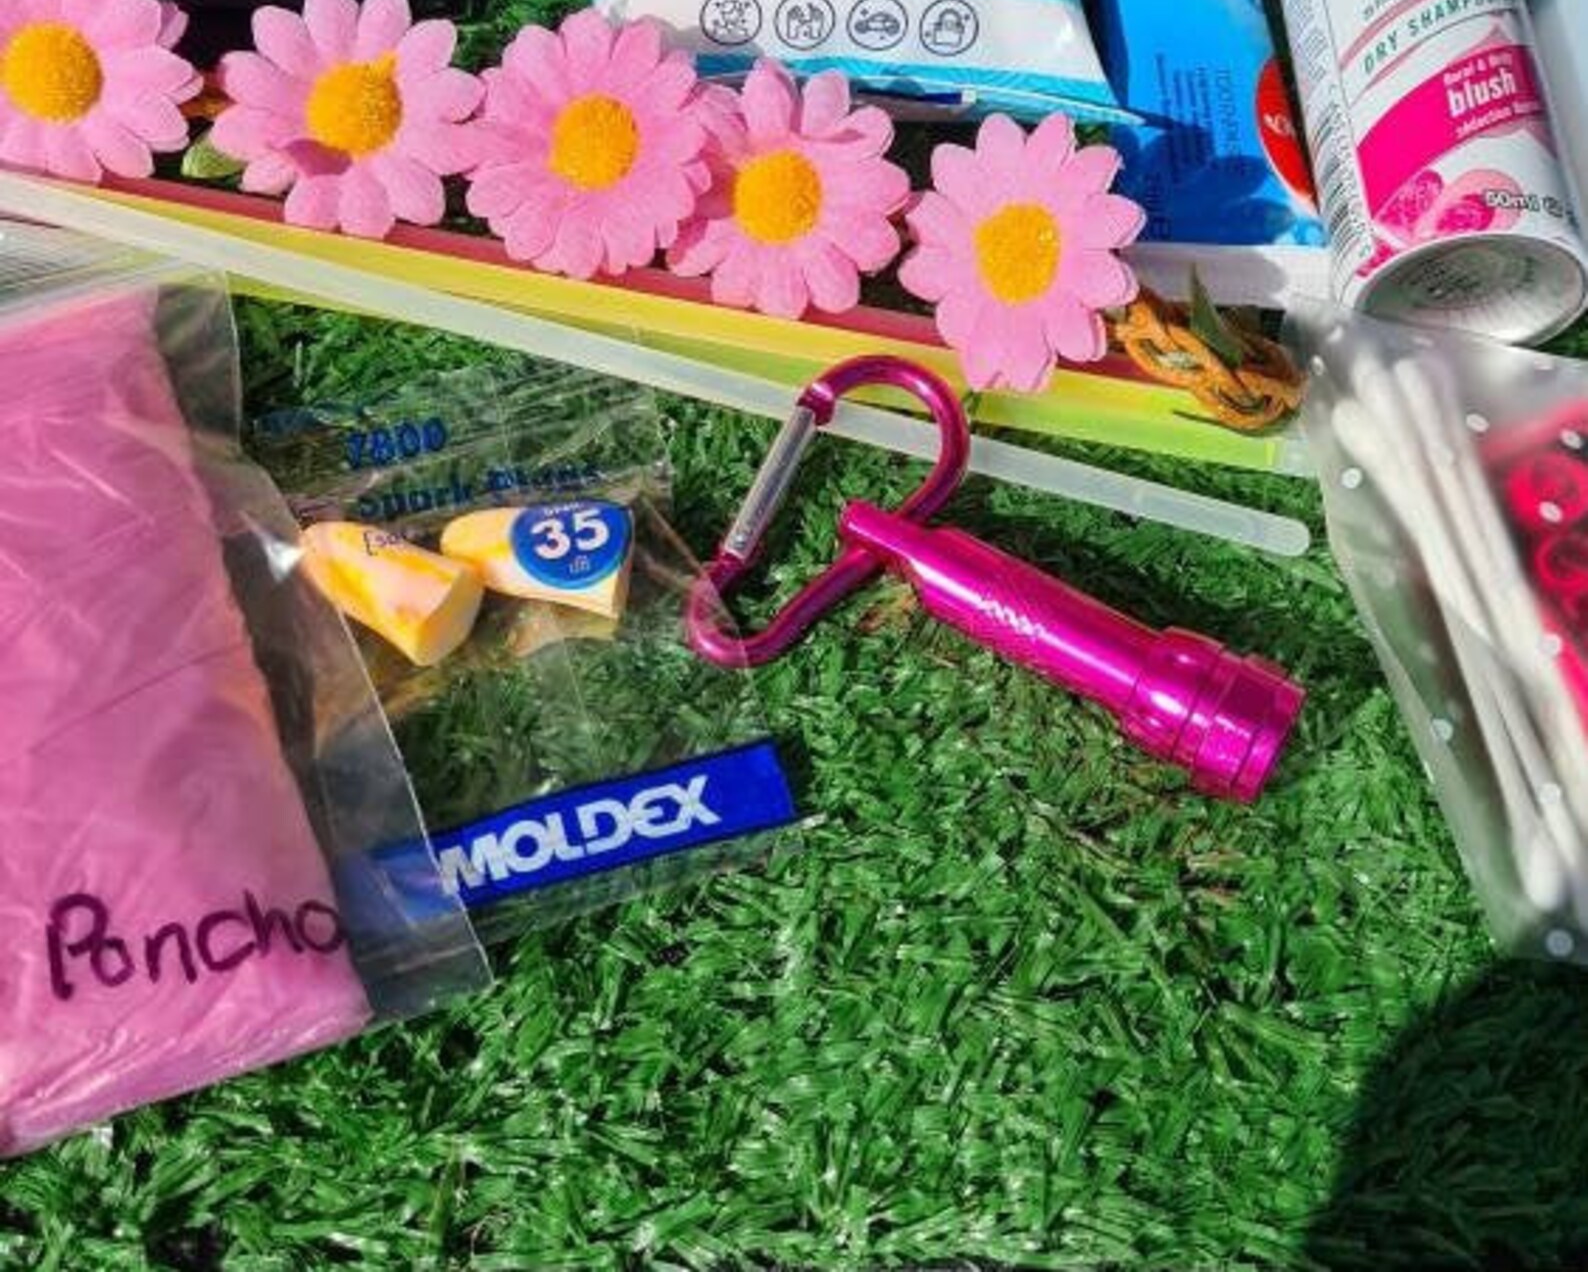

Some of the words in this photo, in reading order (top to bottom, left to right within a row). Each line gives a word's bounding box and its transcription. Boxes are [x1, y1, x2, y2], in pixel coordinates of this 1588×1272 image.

[1363, 30, 1399, 74] DRY
[1446, 67, 1518, 119] blush
[530, 508, 610, 560] 35
[438, 774, 723, 896] MOLDEX
[46, 888, 347, 1001] Poncho
